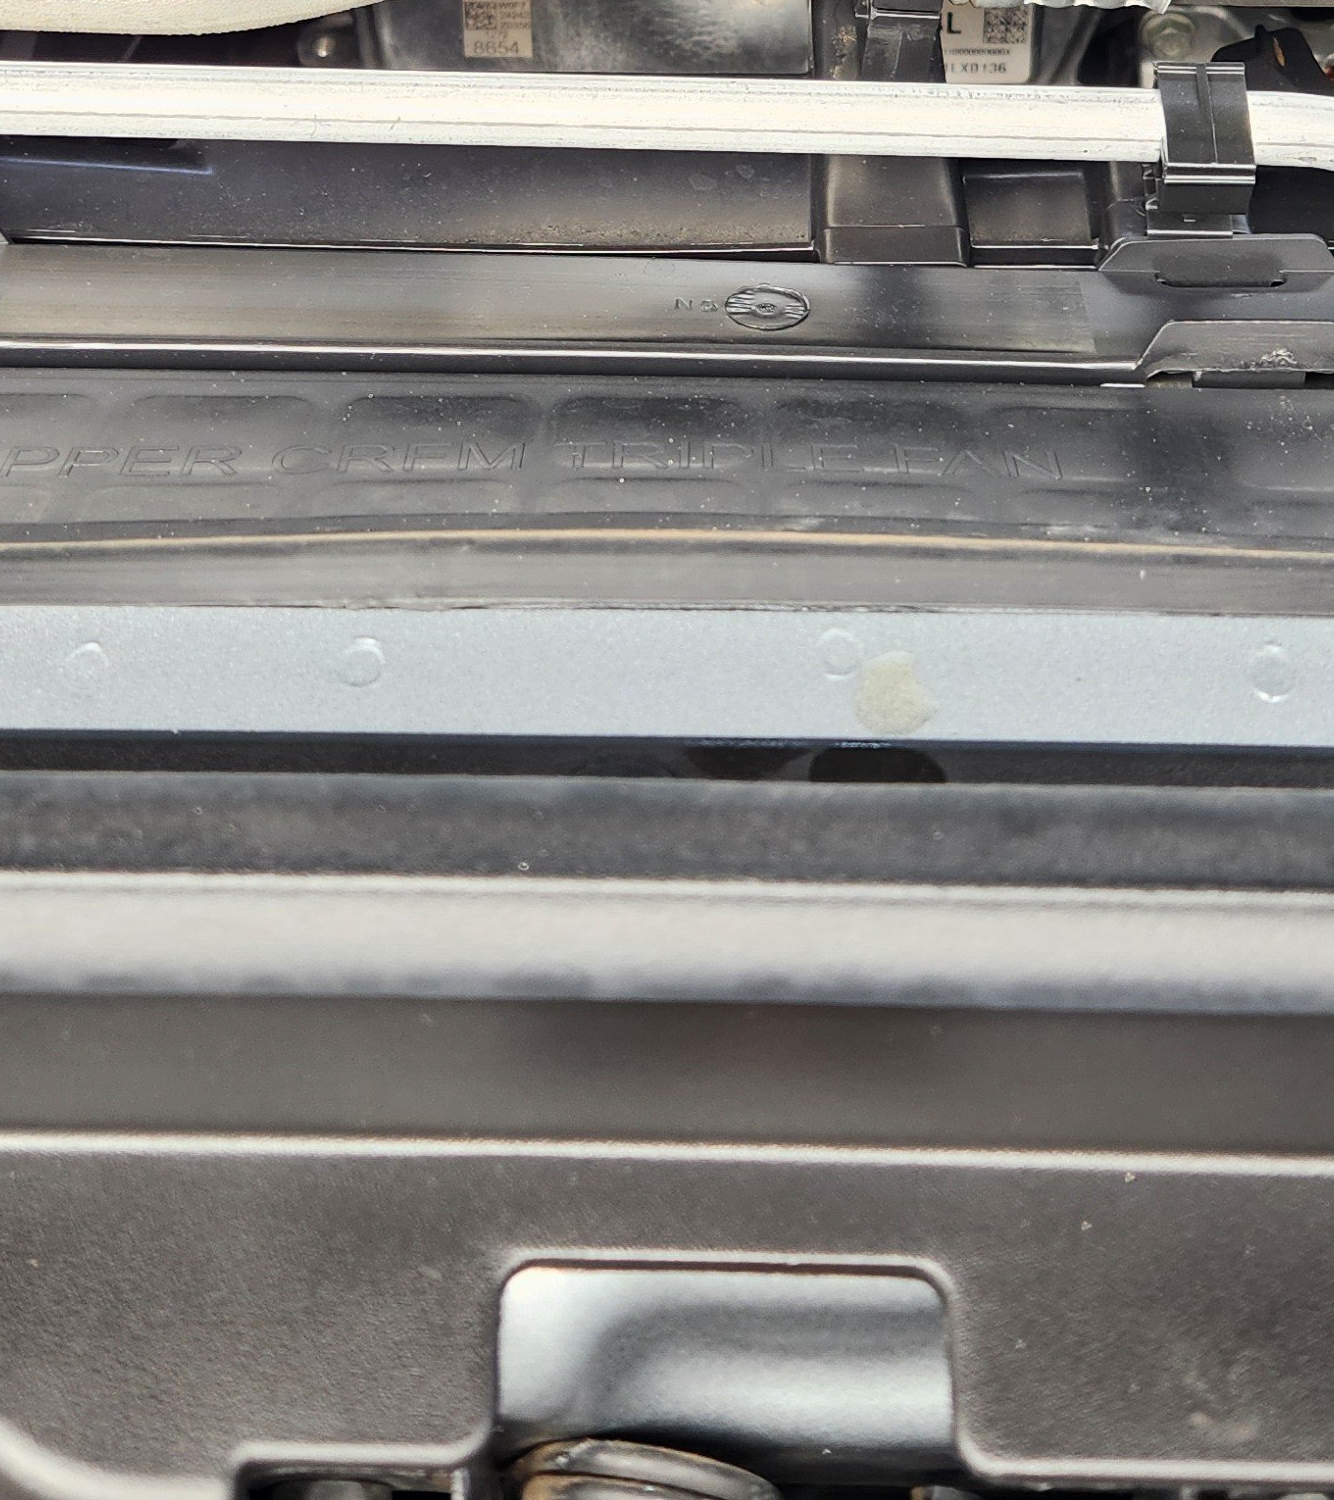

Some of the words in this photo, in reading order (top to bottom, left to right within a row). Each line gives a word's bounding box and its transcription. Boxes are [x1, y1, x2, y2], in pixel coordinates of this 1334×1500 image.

[473, 40, 520, 55] 8654
[269, 443, 528, 475] CRFM
[556, 442, 864, 473] TRIPLE
[895, 444, 1065, 481] FAN
